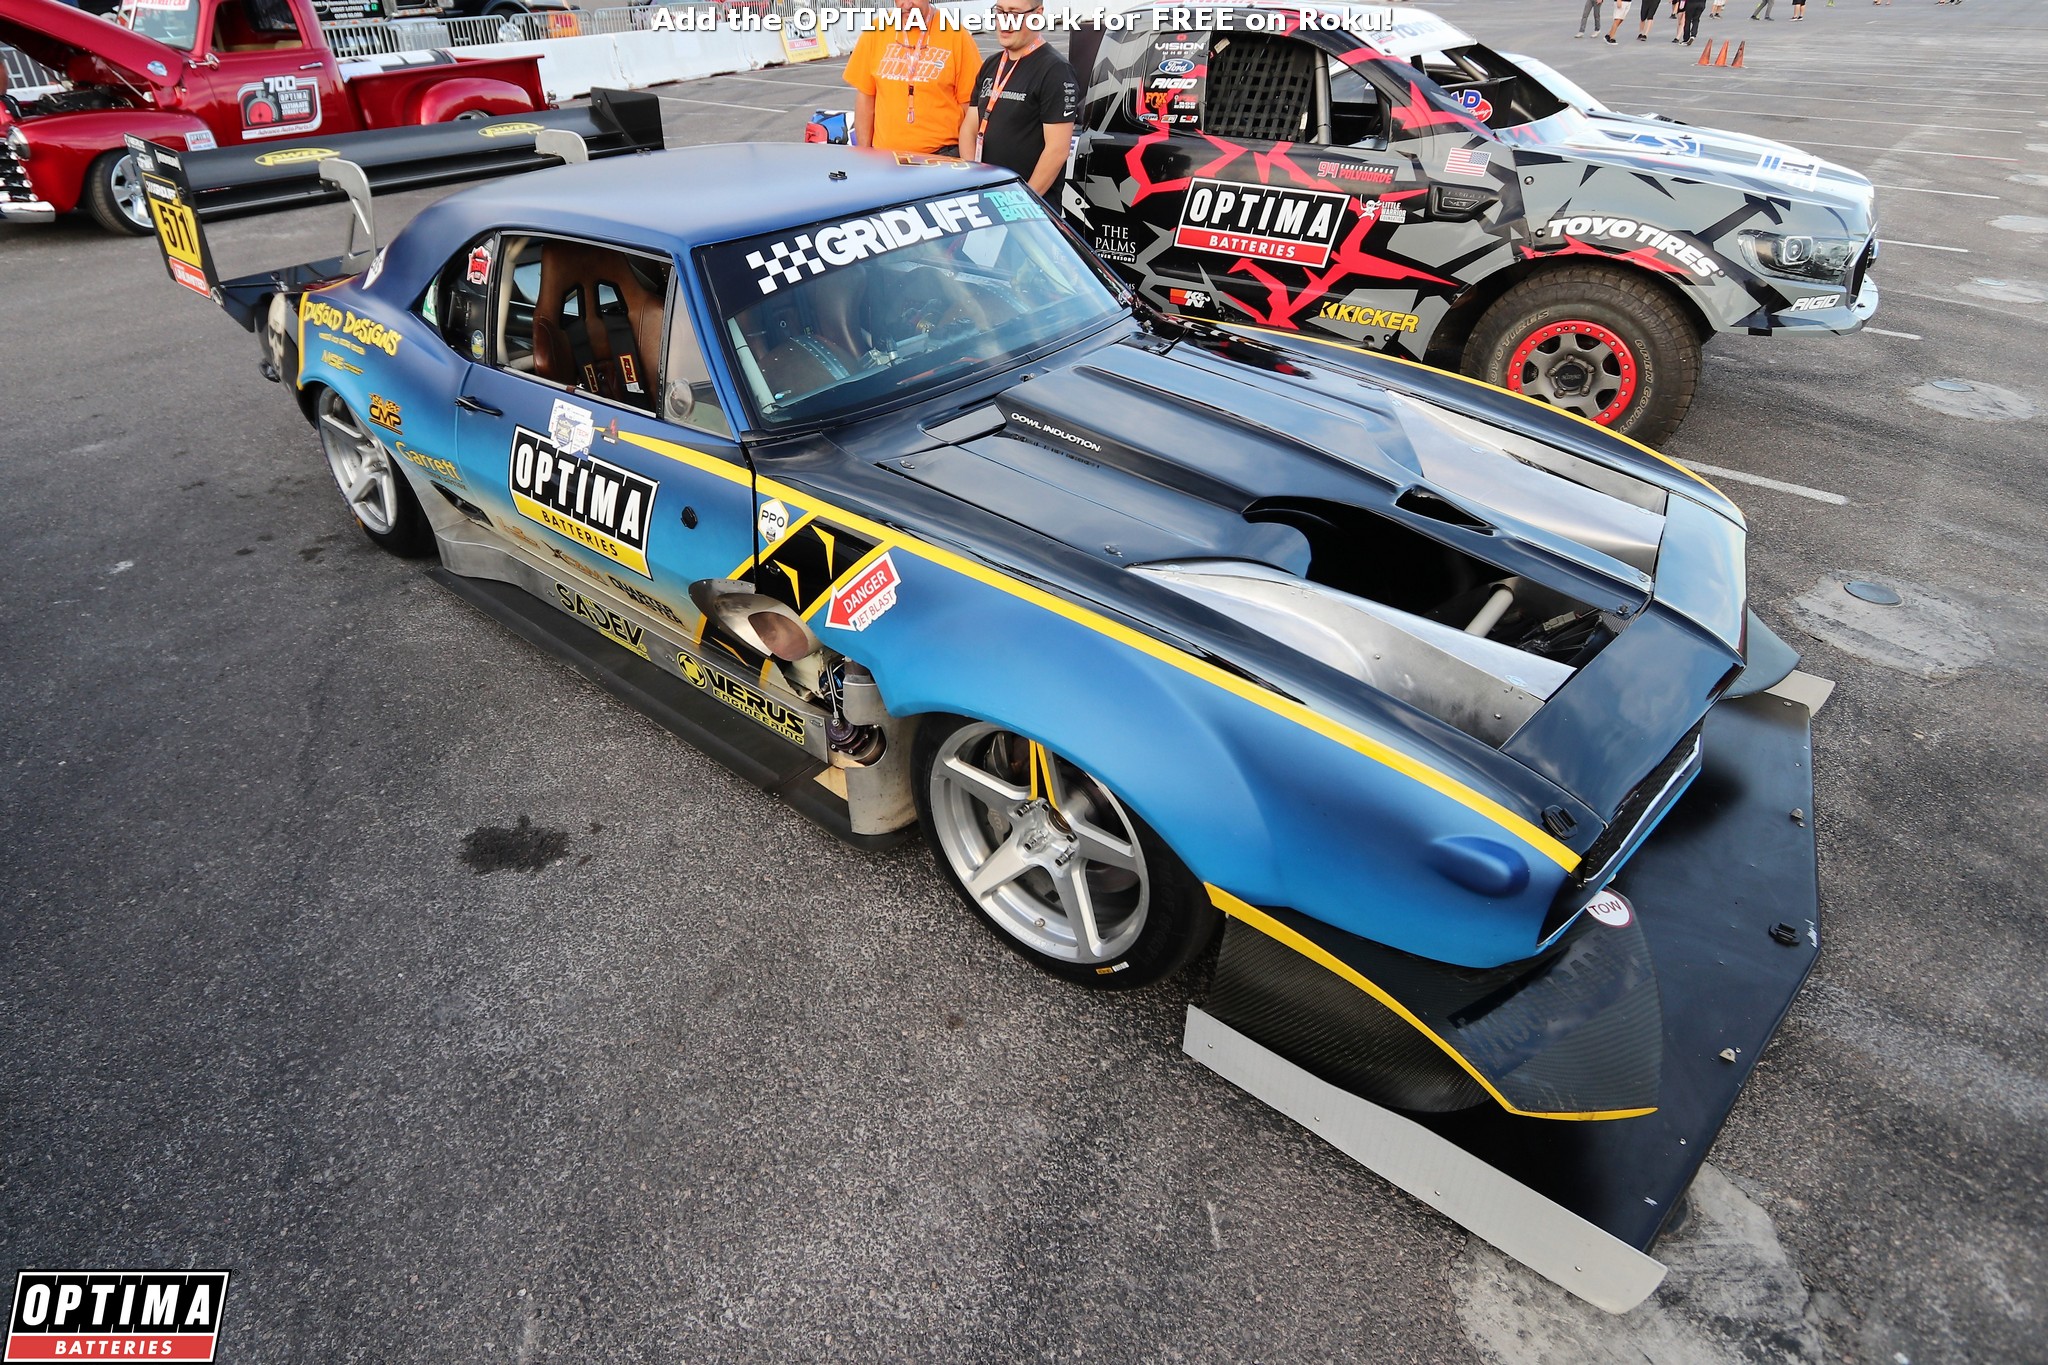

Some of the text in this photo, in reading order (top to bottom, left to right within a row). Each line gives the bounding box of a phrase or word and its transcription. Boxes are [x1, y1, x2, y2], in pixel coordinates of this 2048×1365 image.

[1154, 42, 1206, 51] VISION
[1164, 60, 1188, 72] Ford
[263, 75, 297, 94] 700
[1150, 77, 1198, 90] RIGID
[279, 90, 308, 102] OPTIMA
[1144, 92, 1168, 108] FOX
[1317, 160, 1340, 179] 94
[1339, 169, 1393, 185] POLVOORDE
[1188, 187, 1334, 239] OPTIMA
[1381, 201, 1401, 210] LITTLE
[1381, 207, 1407, 218] WARRIOR
[157, 203, 196, 255] 571
[814, 193, 993, 266] GRIDLIFE
[1101, 224, 1129, 240] THE
[1095, 236, 1137, 254] PALMS
[1208, 235, 1297, 259] BATTERIES
[1547, 215, 1720, 278] TOYO TIRES
[1184, 290, 1211, 308] K&N
[1789, 293, 1842, 312] RIGID
[1340, 303, 1420, 333] KICKER
[1501, 309, 1550, 348] TIRES
[1634, 338, 1654, 384] OPEN
[369, 403, 402, 428] CMP
[395, 440, 462, 481] Garrett
[515, 443, 642, 541] OPTIMA
[760, 509, 785, 528] PPO
[541, 509, 618, 557] BATTERIES
[842, 569, 888, 614] DANGER
[554, 581, 645, 648] SADEV
[855, 590, 895, 628] JET BLAST
[701, 664, 806, 737] VERUS
[711, 686, 806, 746] ENGINEERING
[1588, 899, 1623, 917] TOW
